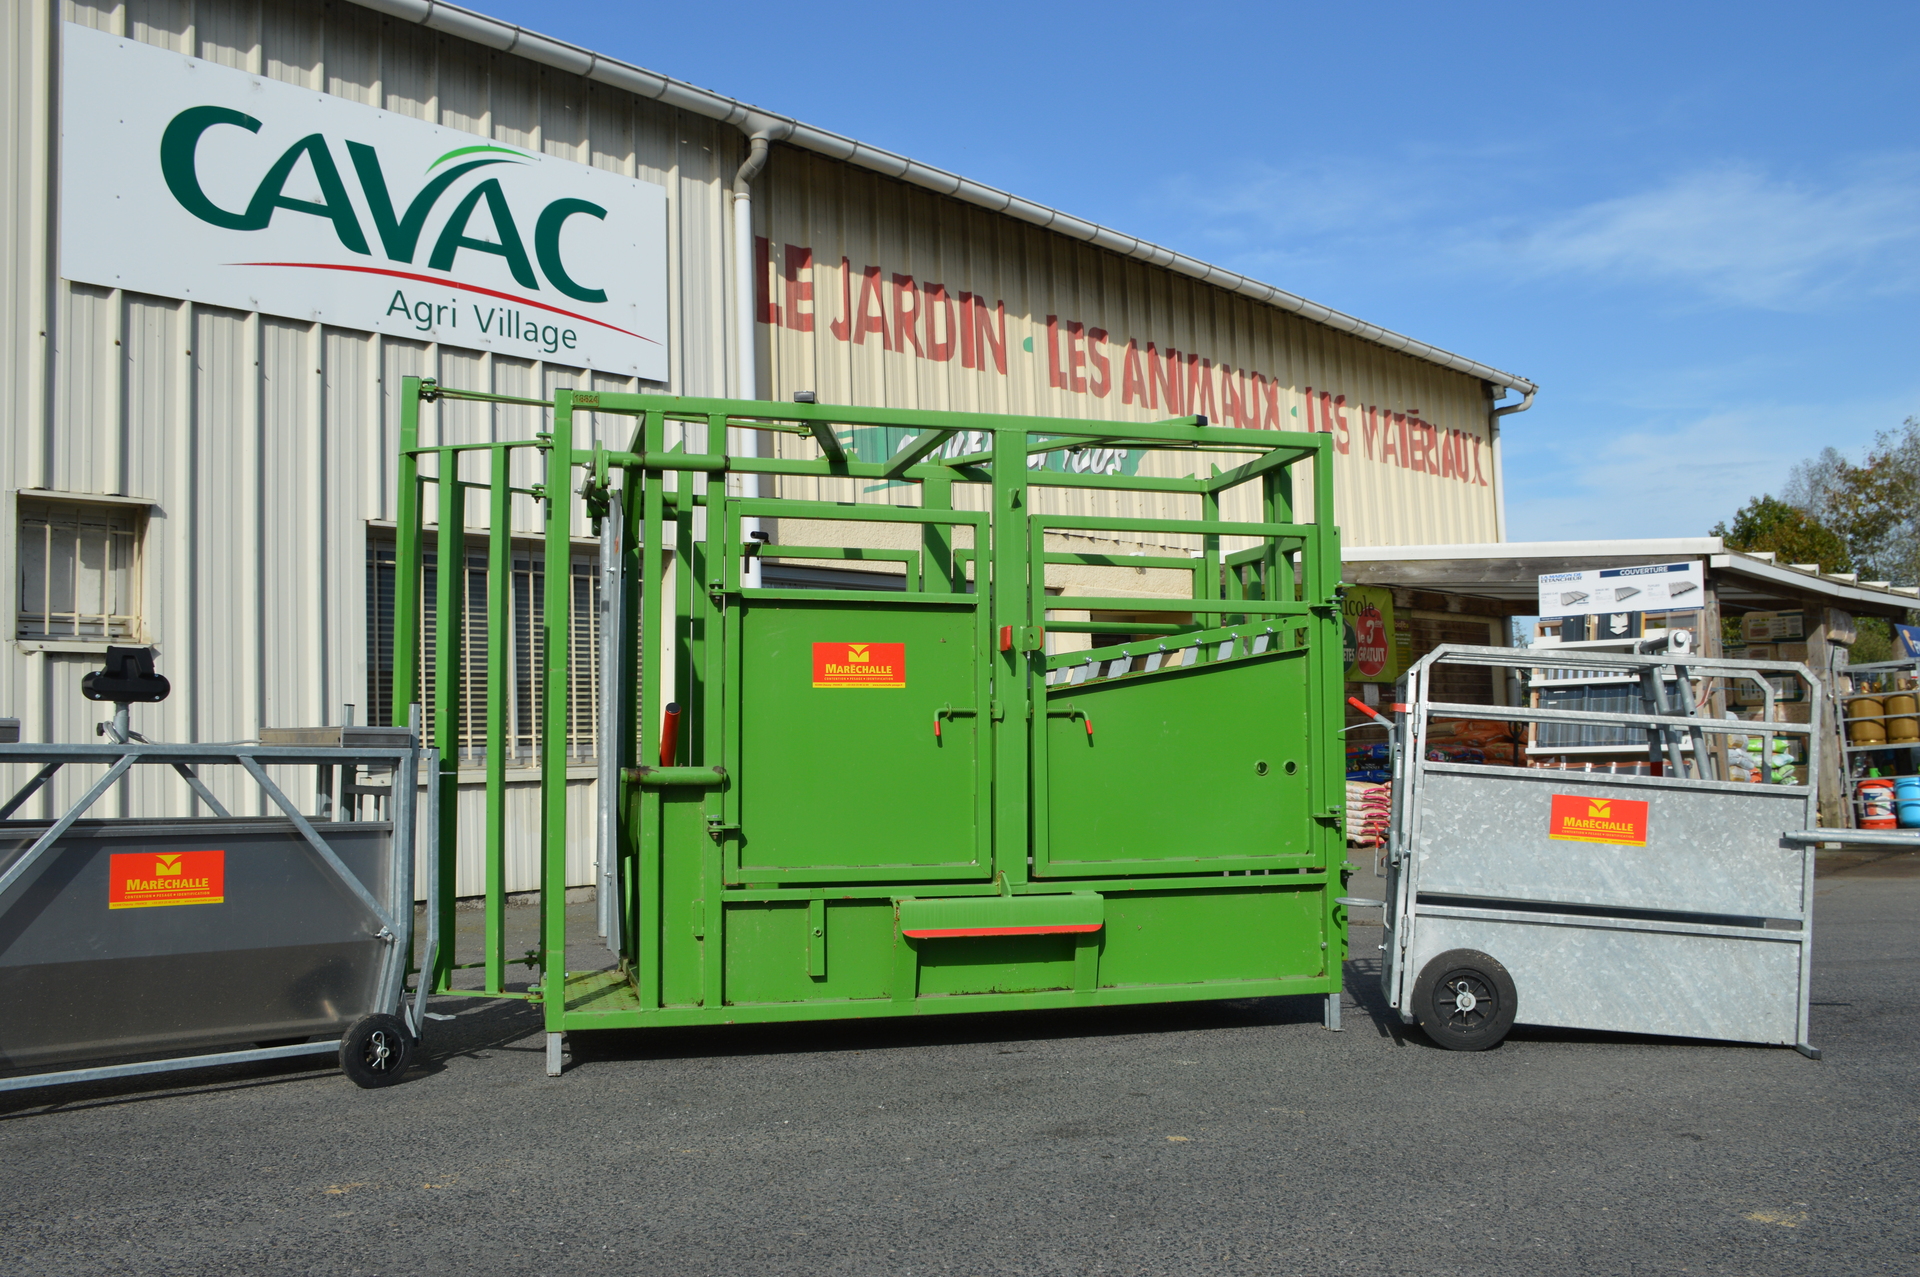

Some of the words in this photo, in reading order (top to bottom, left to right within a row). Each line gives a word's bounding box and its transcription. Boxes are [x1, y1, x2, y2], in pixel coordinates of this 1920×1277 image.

[160, 105, 608, 303] CAVAC
[386, 289, 457, 331] Agri
[473, 304, 578, 354] Village
[755, 235, 814, 332] LE
[829, 256, 1008, 376] JARDIN
[1046, 314, 1112, 399] LES
[1121, 336, 1282, 431] ANIMAUX
[1620, 565, 1668, 576] COUVERTURE
[1342, 595, 1377, 618] icole
[1358, 646, 1385, 663] GRATUIT
